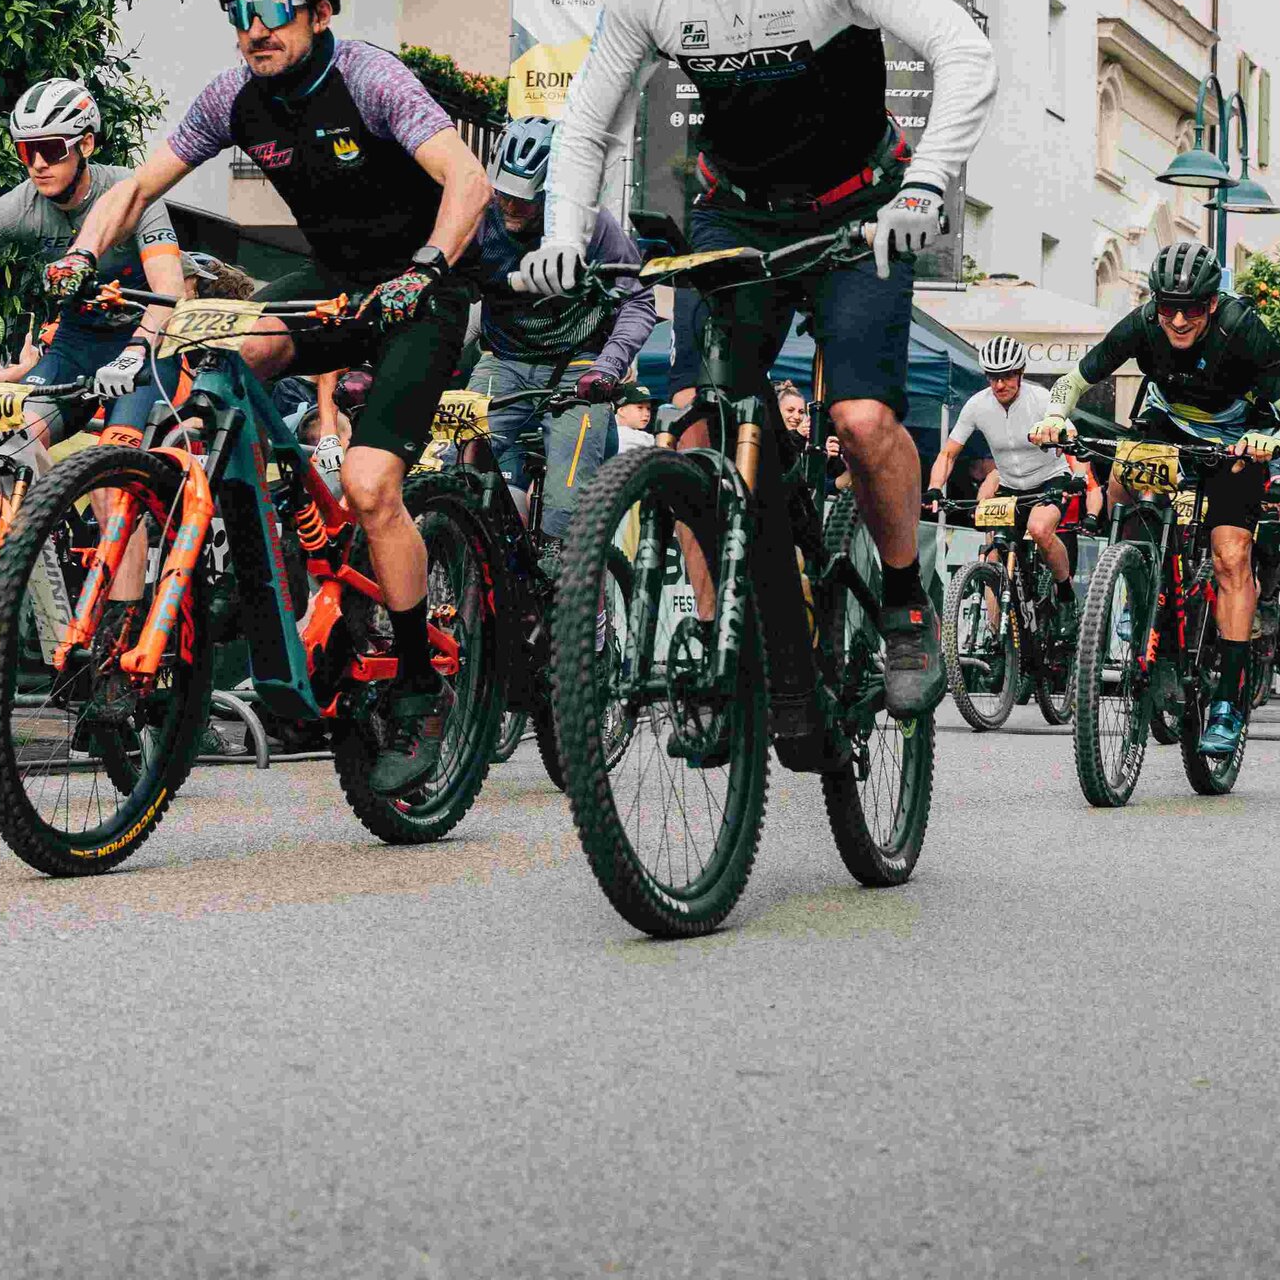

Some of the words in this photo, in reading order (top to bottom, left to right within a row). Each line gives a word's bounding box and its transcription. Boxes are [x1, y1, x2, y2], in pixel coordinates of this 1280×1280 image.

[551, 0, 596, 7] TRENTINO
[687, 45, 799, 72] GRAVITY
[526, 70, 574, 89] ERDIN
[892, 116, 926, 127] XXIS
[179, 311, 238, 334] 2223
[109, 430, 140, 448] TEE
[1122, 462, 1170, 487] 2279
[96, 804, 156, 860] SCORPION
